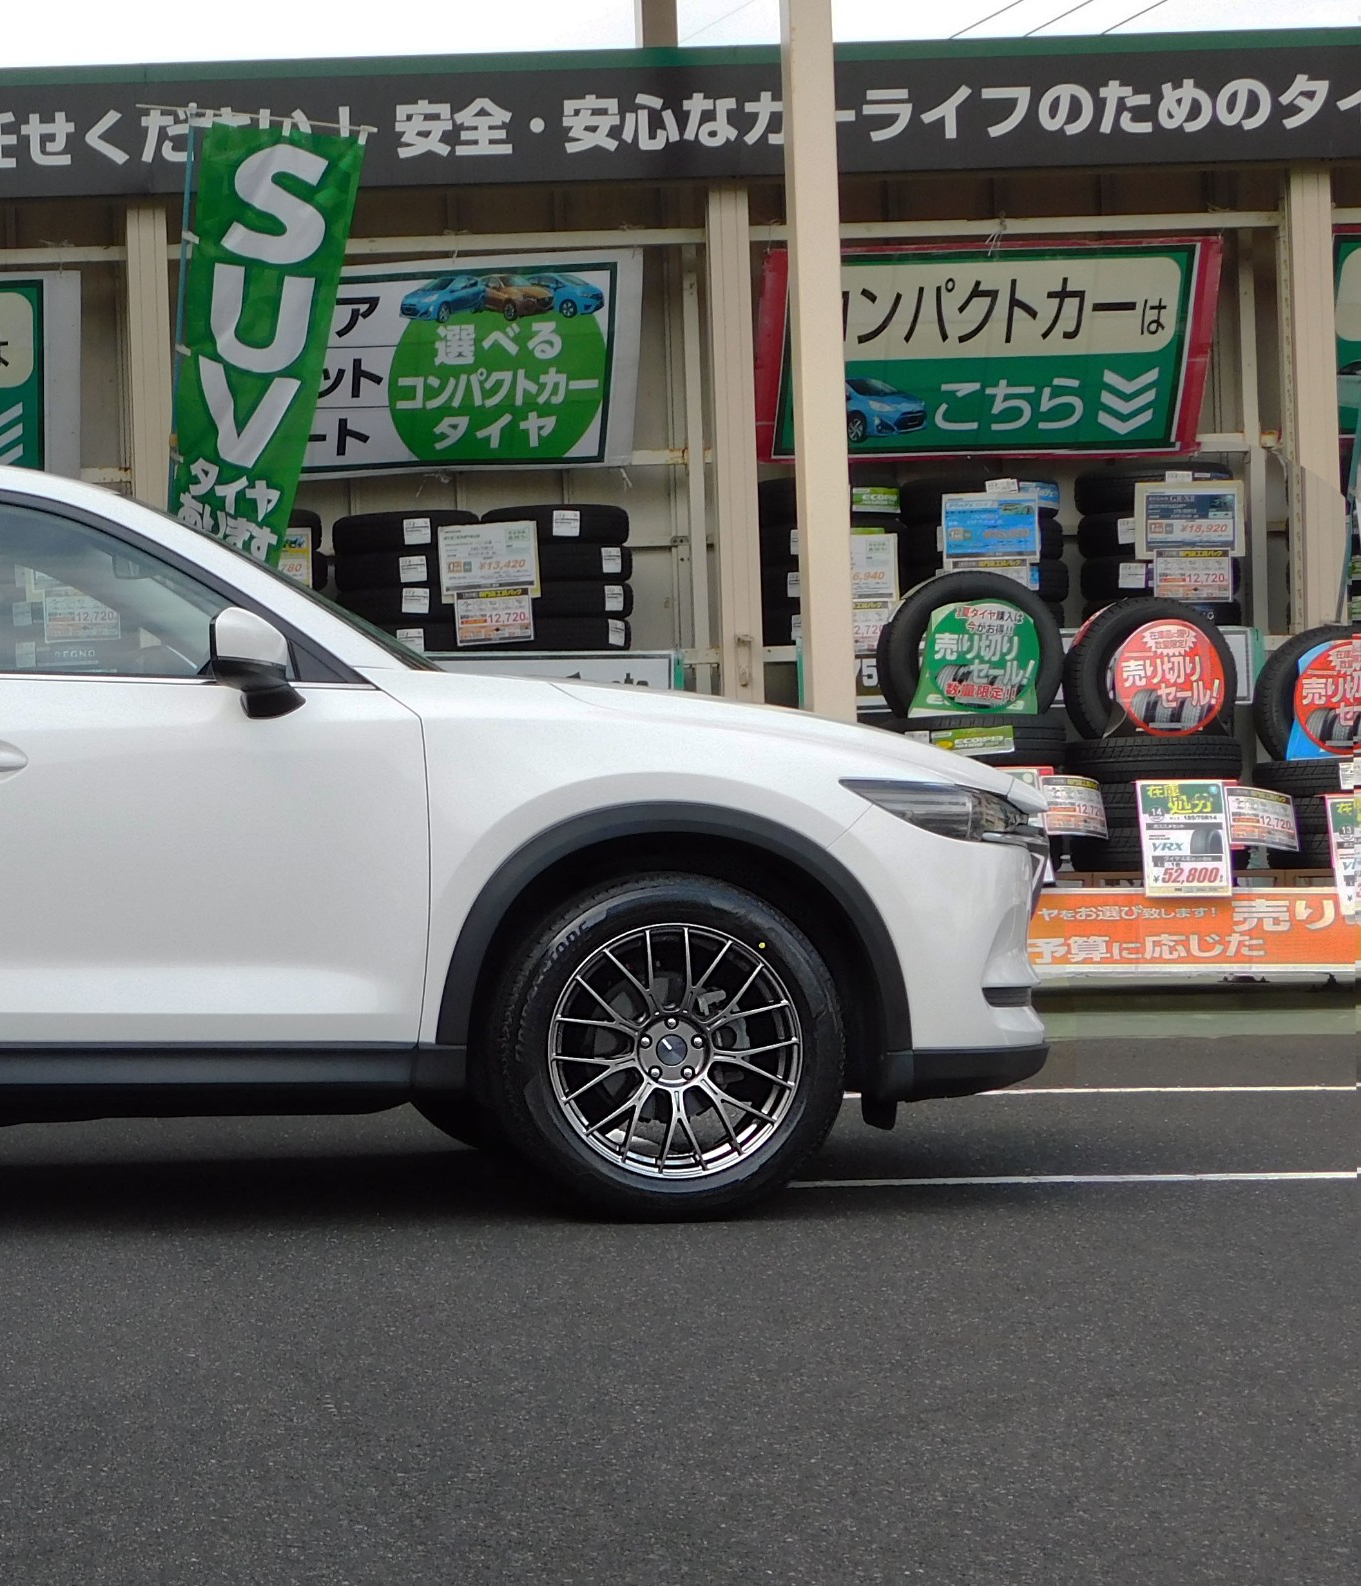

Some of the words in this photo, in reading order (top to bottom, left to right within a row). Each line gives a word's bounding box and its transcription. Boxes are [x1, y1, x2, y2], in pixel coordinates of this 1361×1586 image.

[199, 144, 329, 469] SUV
[842, 277, 1167, 344] ンパクトカーは
[434, 321, 562, 366] 選べる
[396, 367, 599, 410] コンパクトカー
[934, 377, 1084, 431] こちら
[433, 411, 557, 450] タイヤ
[189, 457, 281, 522] タイヤ
[1187, 573, 1226, 584] 12,720
[76, 611, 114, 622] 12,720
[488, 612, 527, 623] 12,720
[934, 633, 1018, 660] 売り切り
[970, 660, 1035, 685] セール!
[1121, 656, 1201, 688] 売り切り
[1158, 679, 1220, 708] セール!
[1146, 784, 1180, 798] 在庫
[1168, 793, 1214, 815] 処分
[1151, 808, 1162, 816] 14
[1260, 815, 1291, 830] 12,720
[1151, 842, 1184, 852] VRX
[1028, 933, 1265, 964] 予算に応じた
